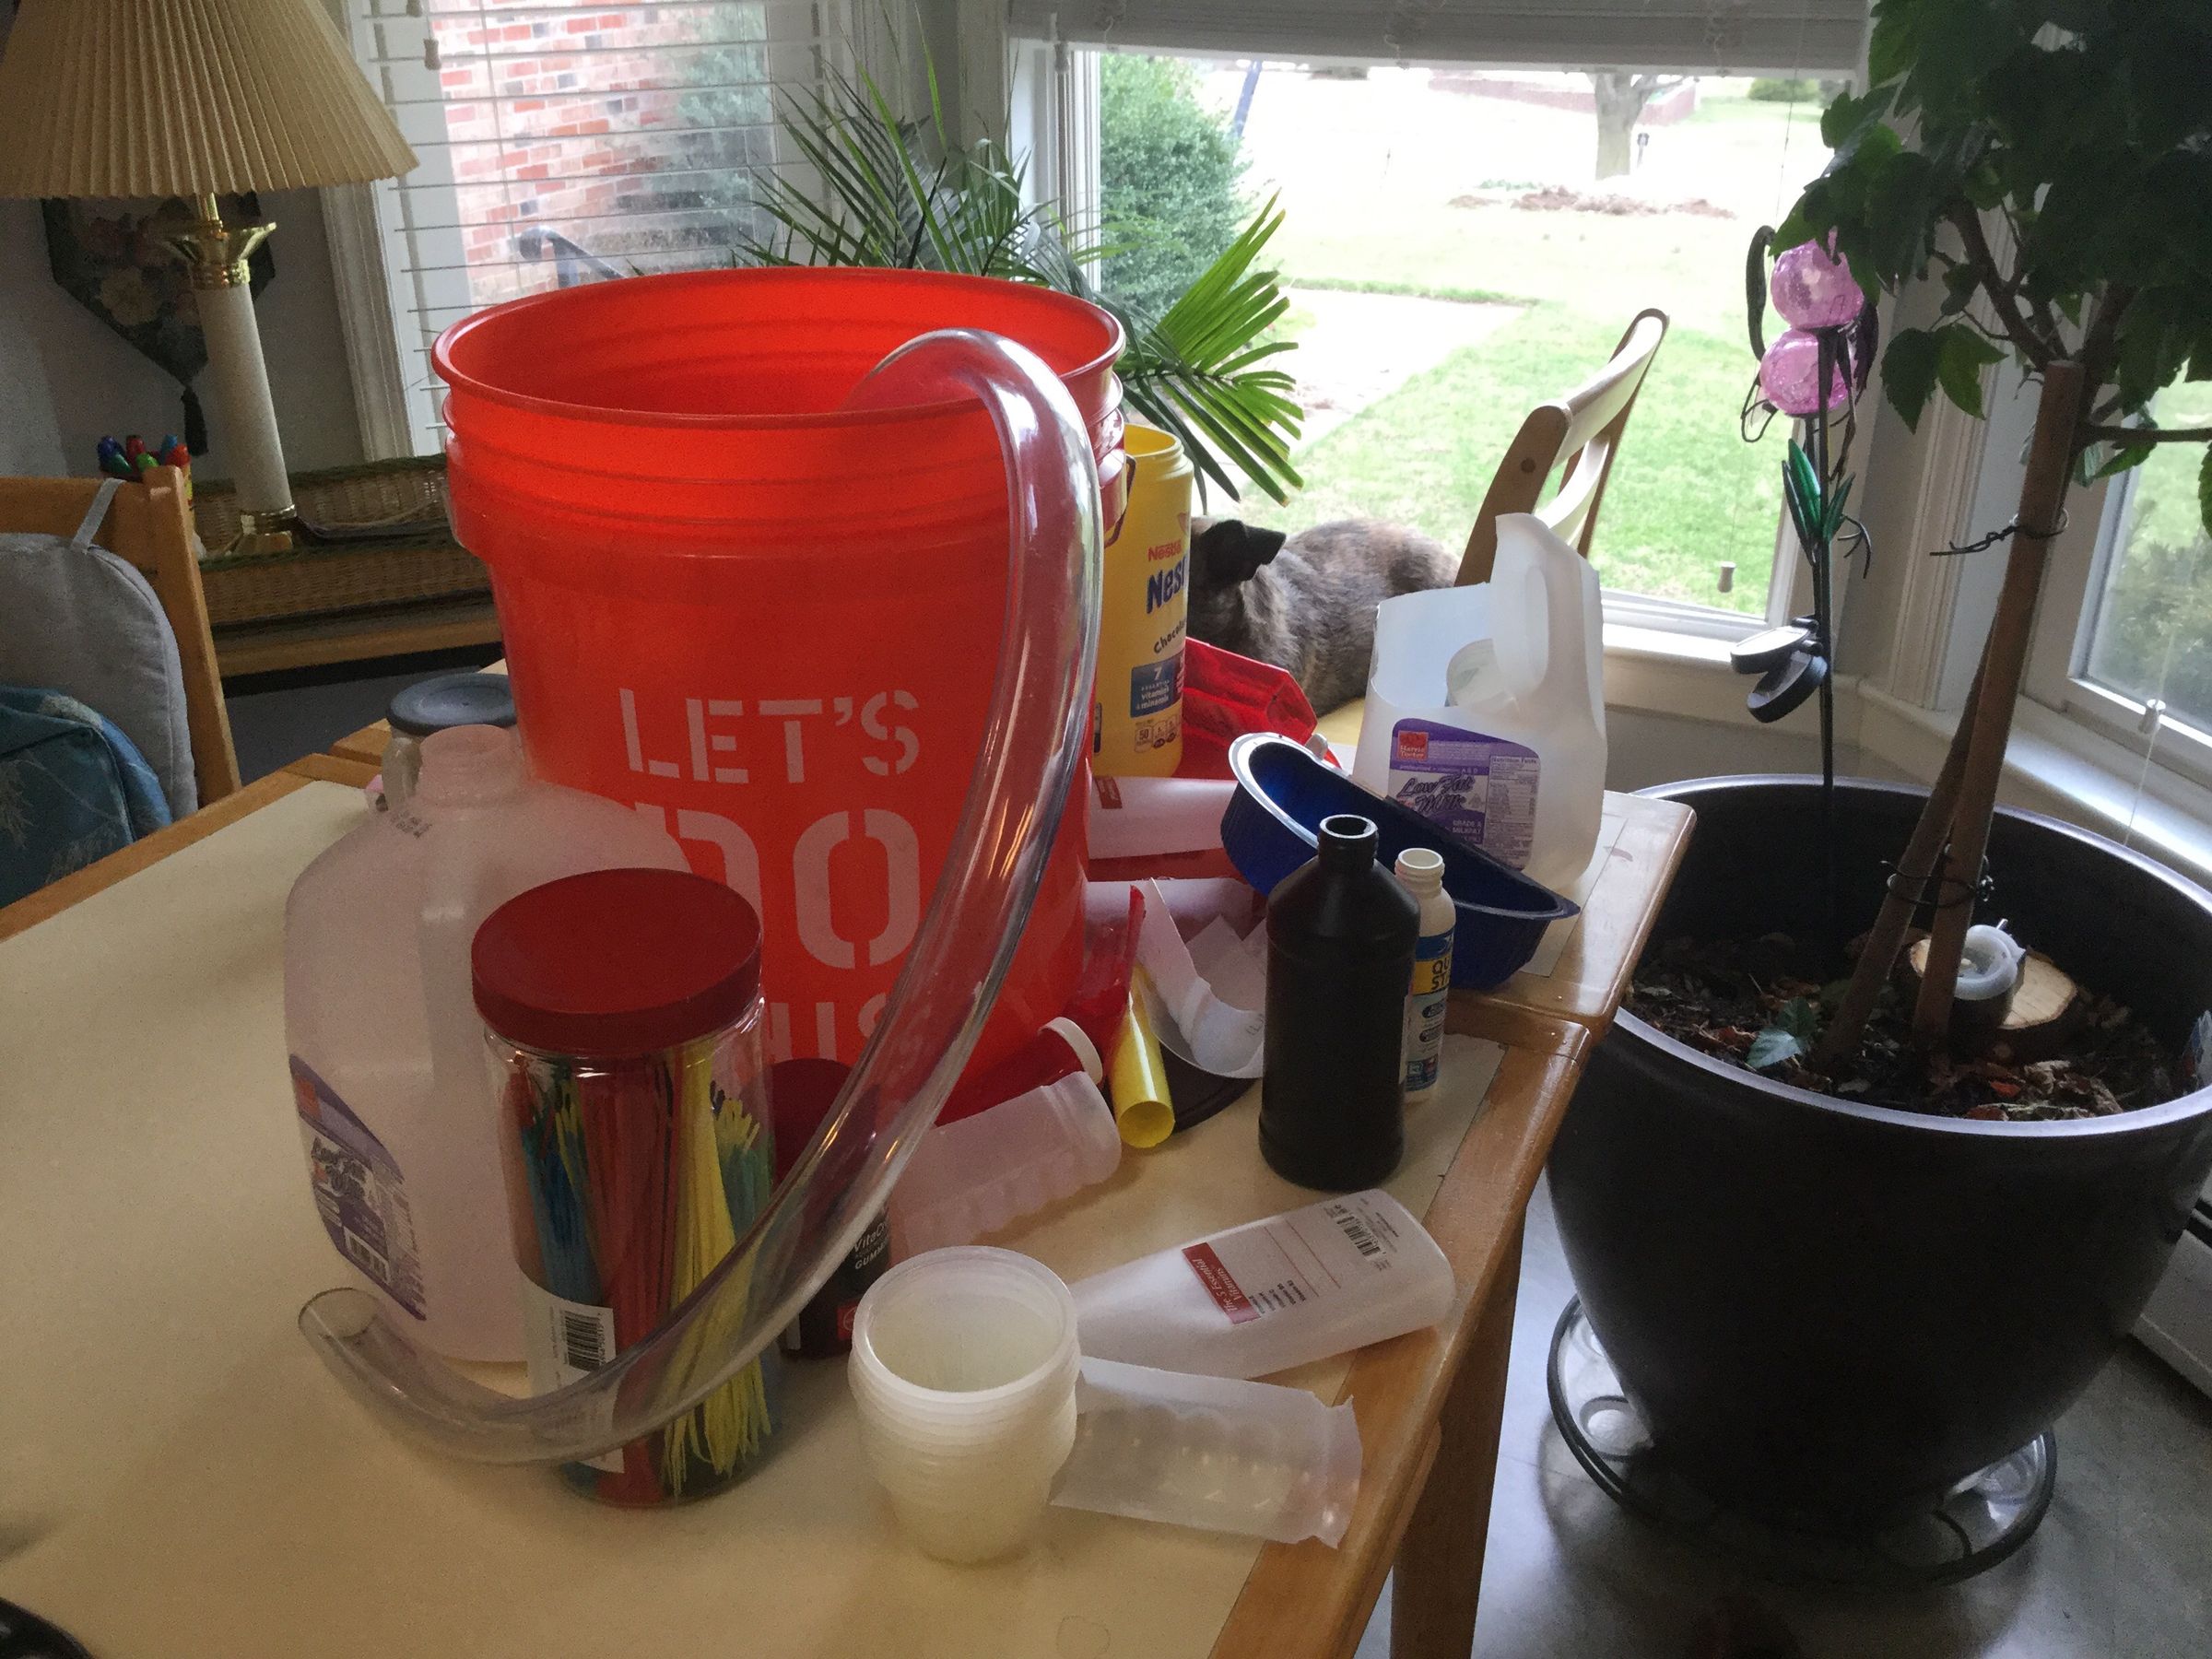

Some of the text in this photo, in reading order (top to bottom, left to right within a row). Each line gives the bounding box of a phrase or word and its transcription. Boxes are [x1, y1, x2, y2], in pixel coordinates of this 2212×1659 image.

[1154, 666, 1162, 680] 7
[619, 688, 920, 783] LET'S
[1193, 1258, 1222, 1290] Essential
[1216, 1267, 1241, 1300] Vitamins
